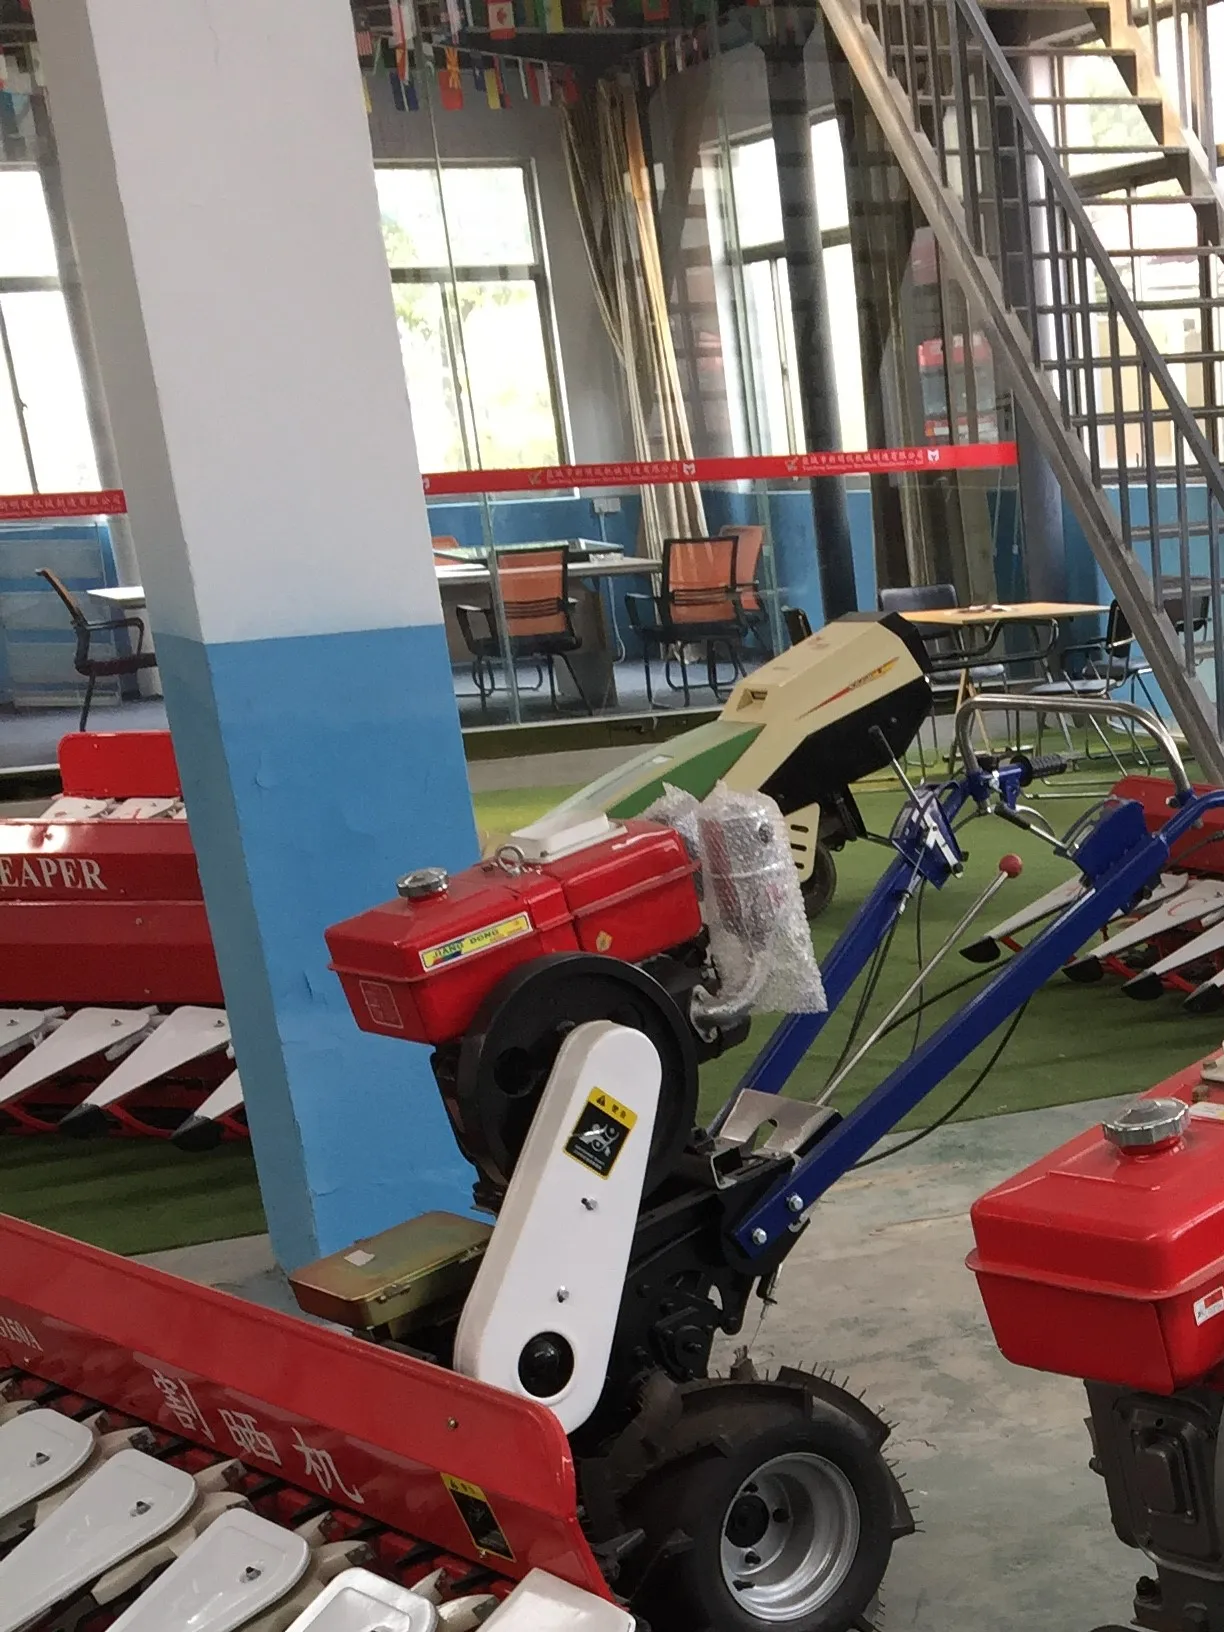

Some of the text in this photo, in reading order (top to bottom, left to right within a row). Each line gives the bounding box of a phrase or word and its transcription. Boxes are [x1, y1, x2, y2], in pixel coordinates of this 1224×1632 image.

[0, 856, 108, 890] EAPER
[151, 1368, 366, 1505] 割晒机
